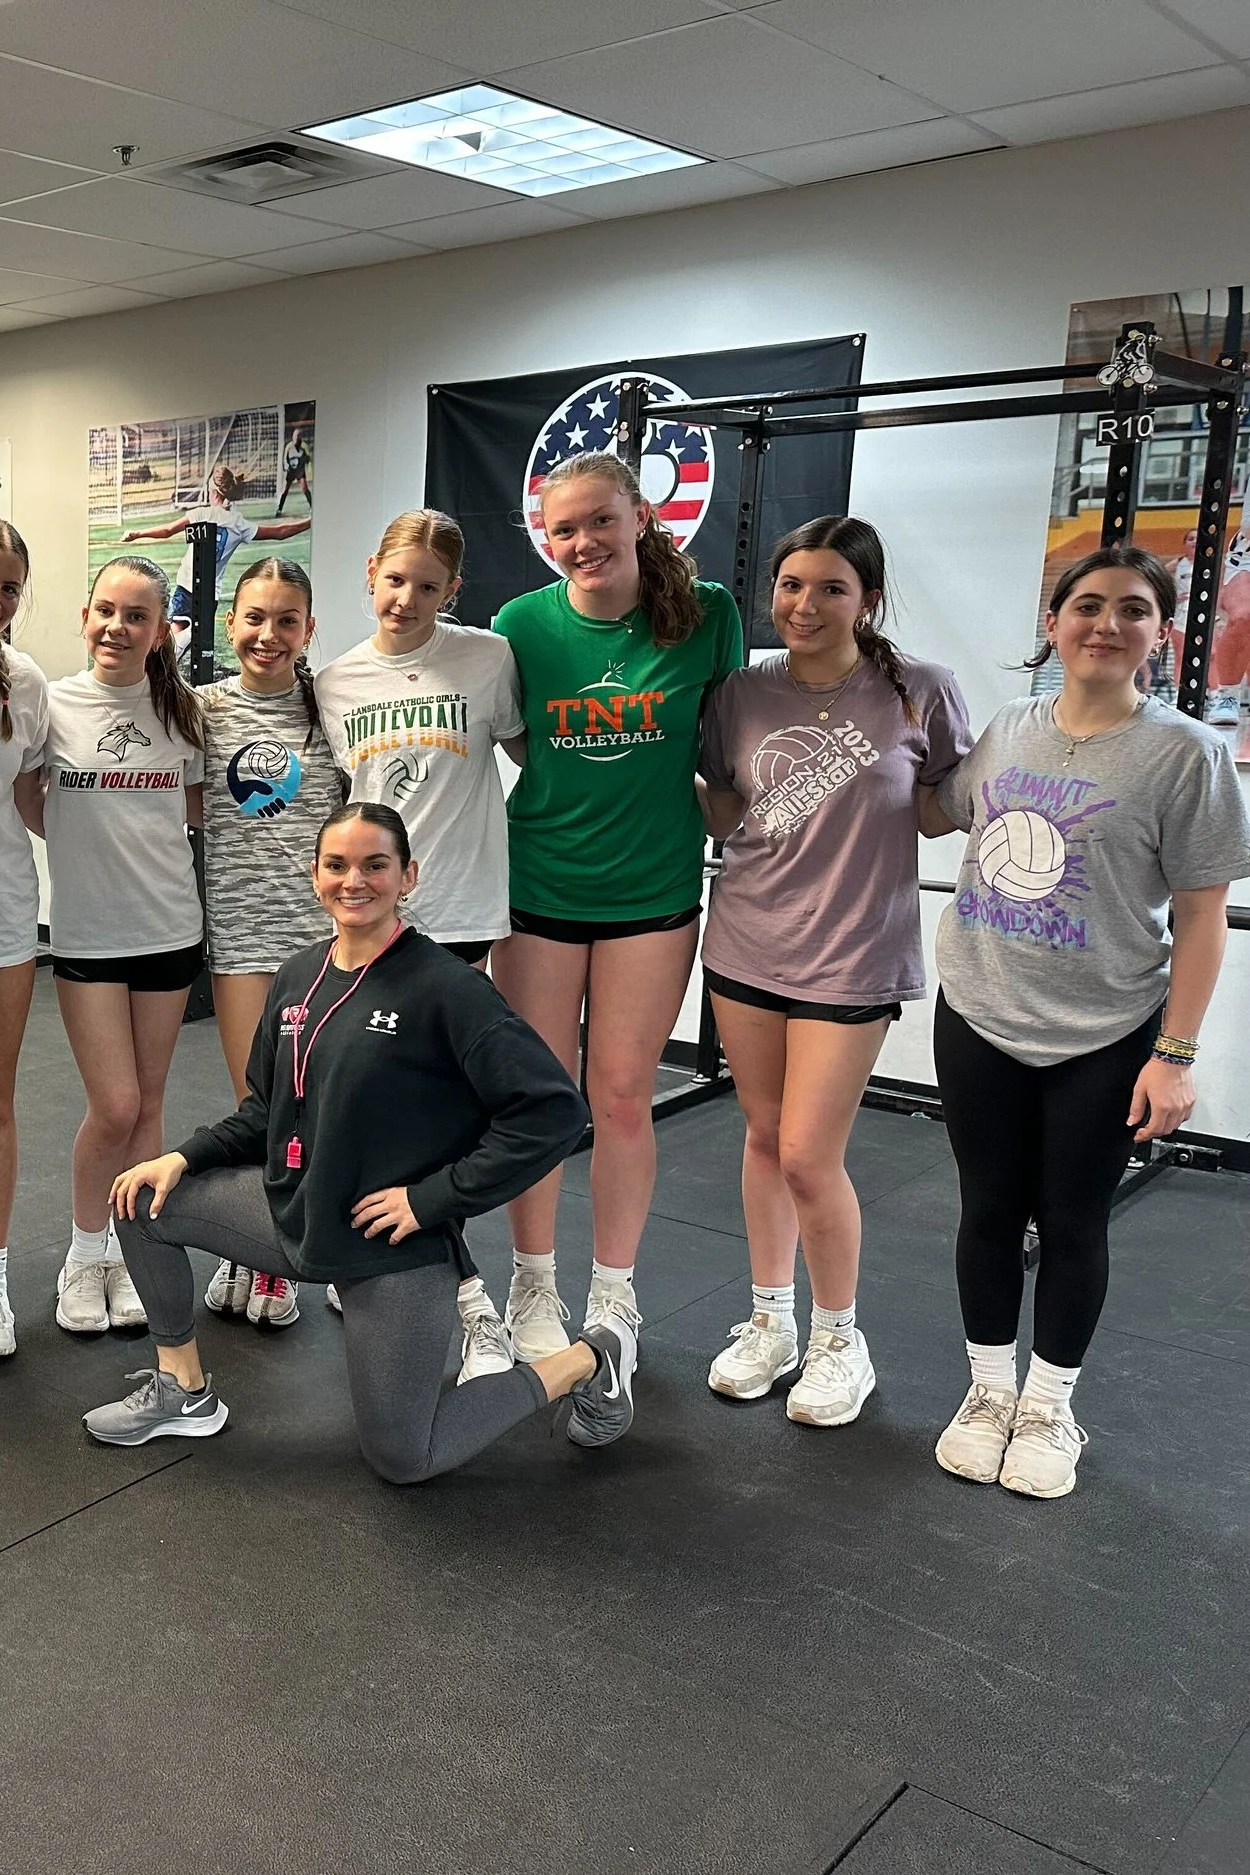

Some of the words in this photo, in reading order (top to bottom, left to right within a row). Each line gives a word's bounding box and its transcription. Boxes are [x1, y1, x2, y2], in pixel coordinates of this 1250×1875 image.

[1098, 414, 1153, 442] R10
[186, 525, 207, 541] R11
[351, 702, 392, 717] LANSDALE
[394, 695, 434, 709] CATHOLIC
[547, 691, 664, 735] TNT
[549, 730, 665, 749] VOLLEYBALL
[833, 720, 880, 766] 2023
[59, 770, 98, 789] RIDER
[100, 771, 180, 789] VOLLEYBALL
[750, 765, 814, 819] REGION
[775, 758, 857, 829] All-Star
